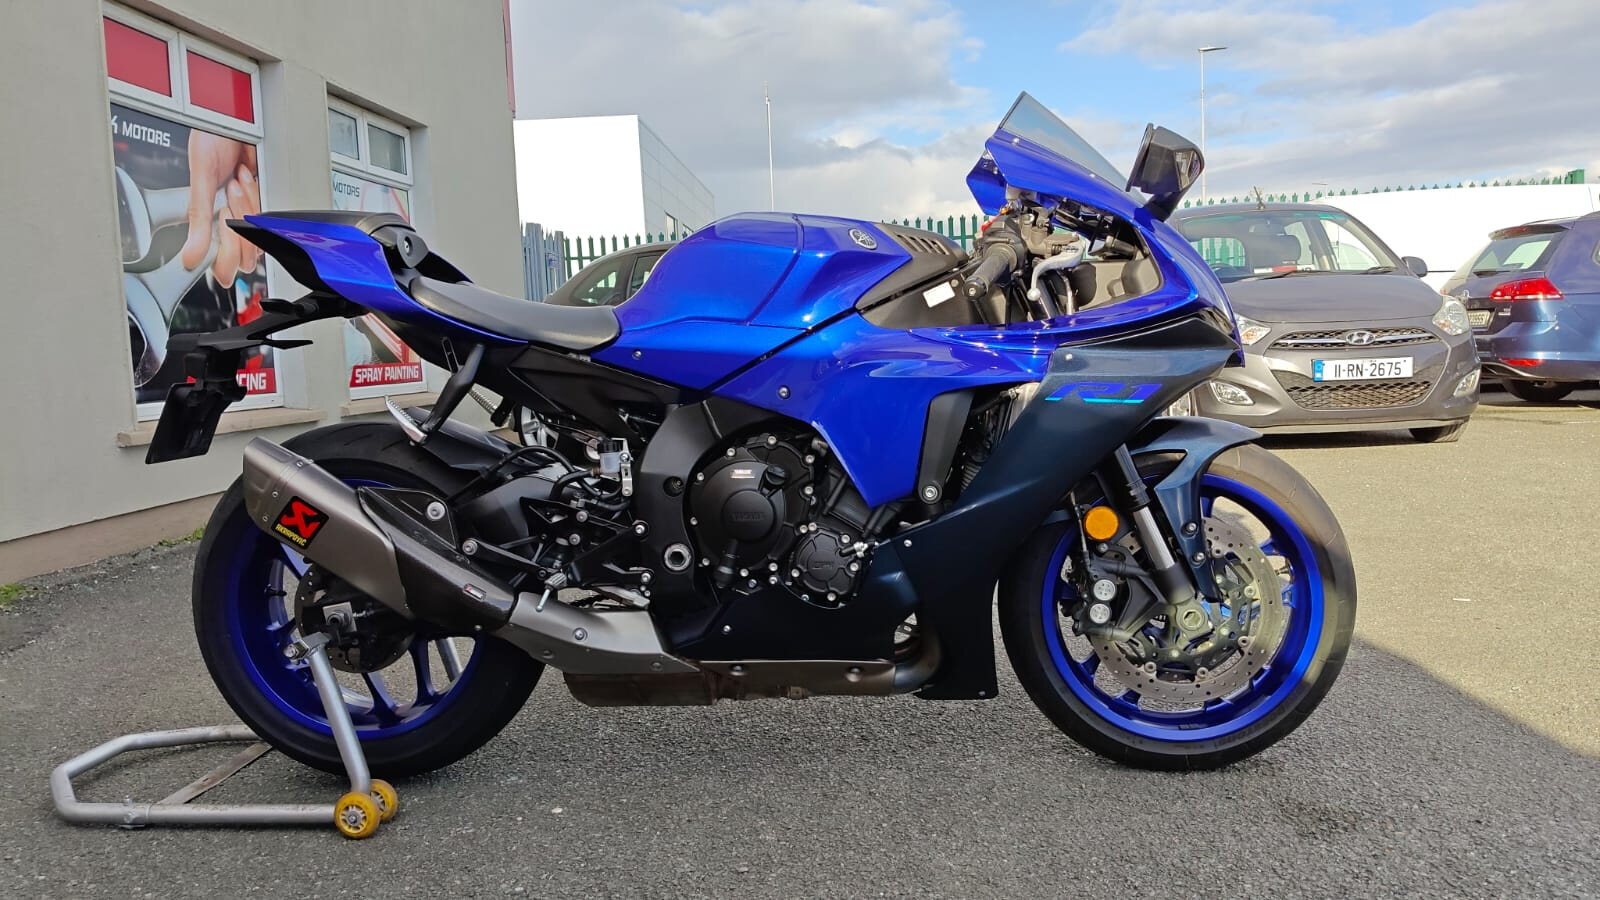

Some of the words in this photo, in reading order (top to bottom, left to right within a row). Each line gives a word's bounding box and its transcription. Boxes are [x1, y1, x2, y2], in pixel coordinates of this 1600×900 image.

[122, 121, 171, 148] MOTORS
[333, 181, 360, 198] MOTORS
[355, 367, 383, 384] SPRAY
[384, 365, 419, 381] PAINTING
[1334, 362, 1402, 378] 11-RN-2675
[236, 372, 267, 391] CING
[1045, 382, 1163, 404] R1
